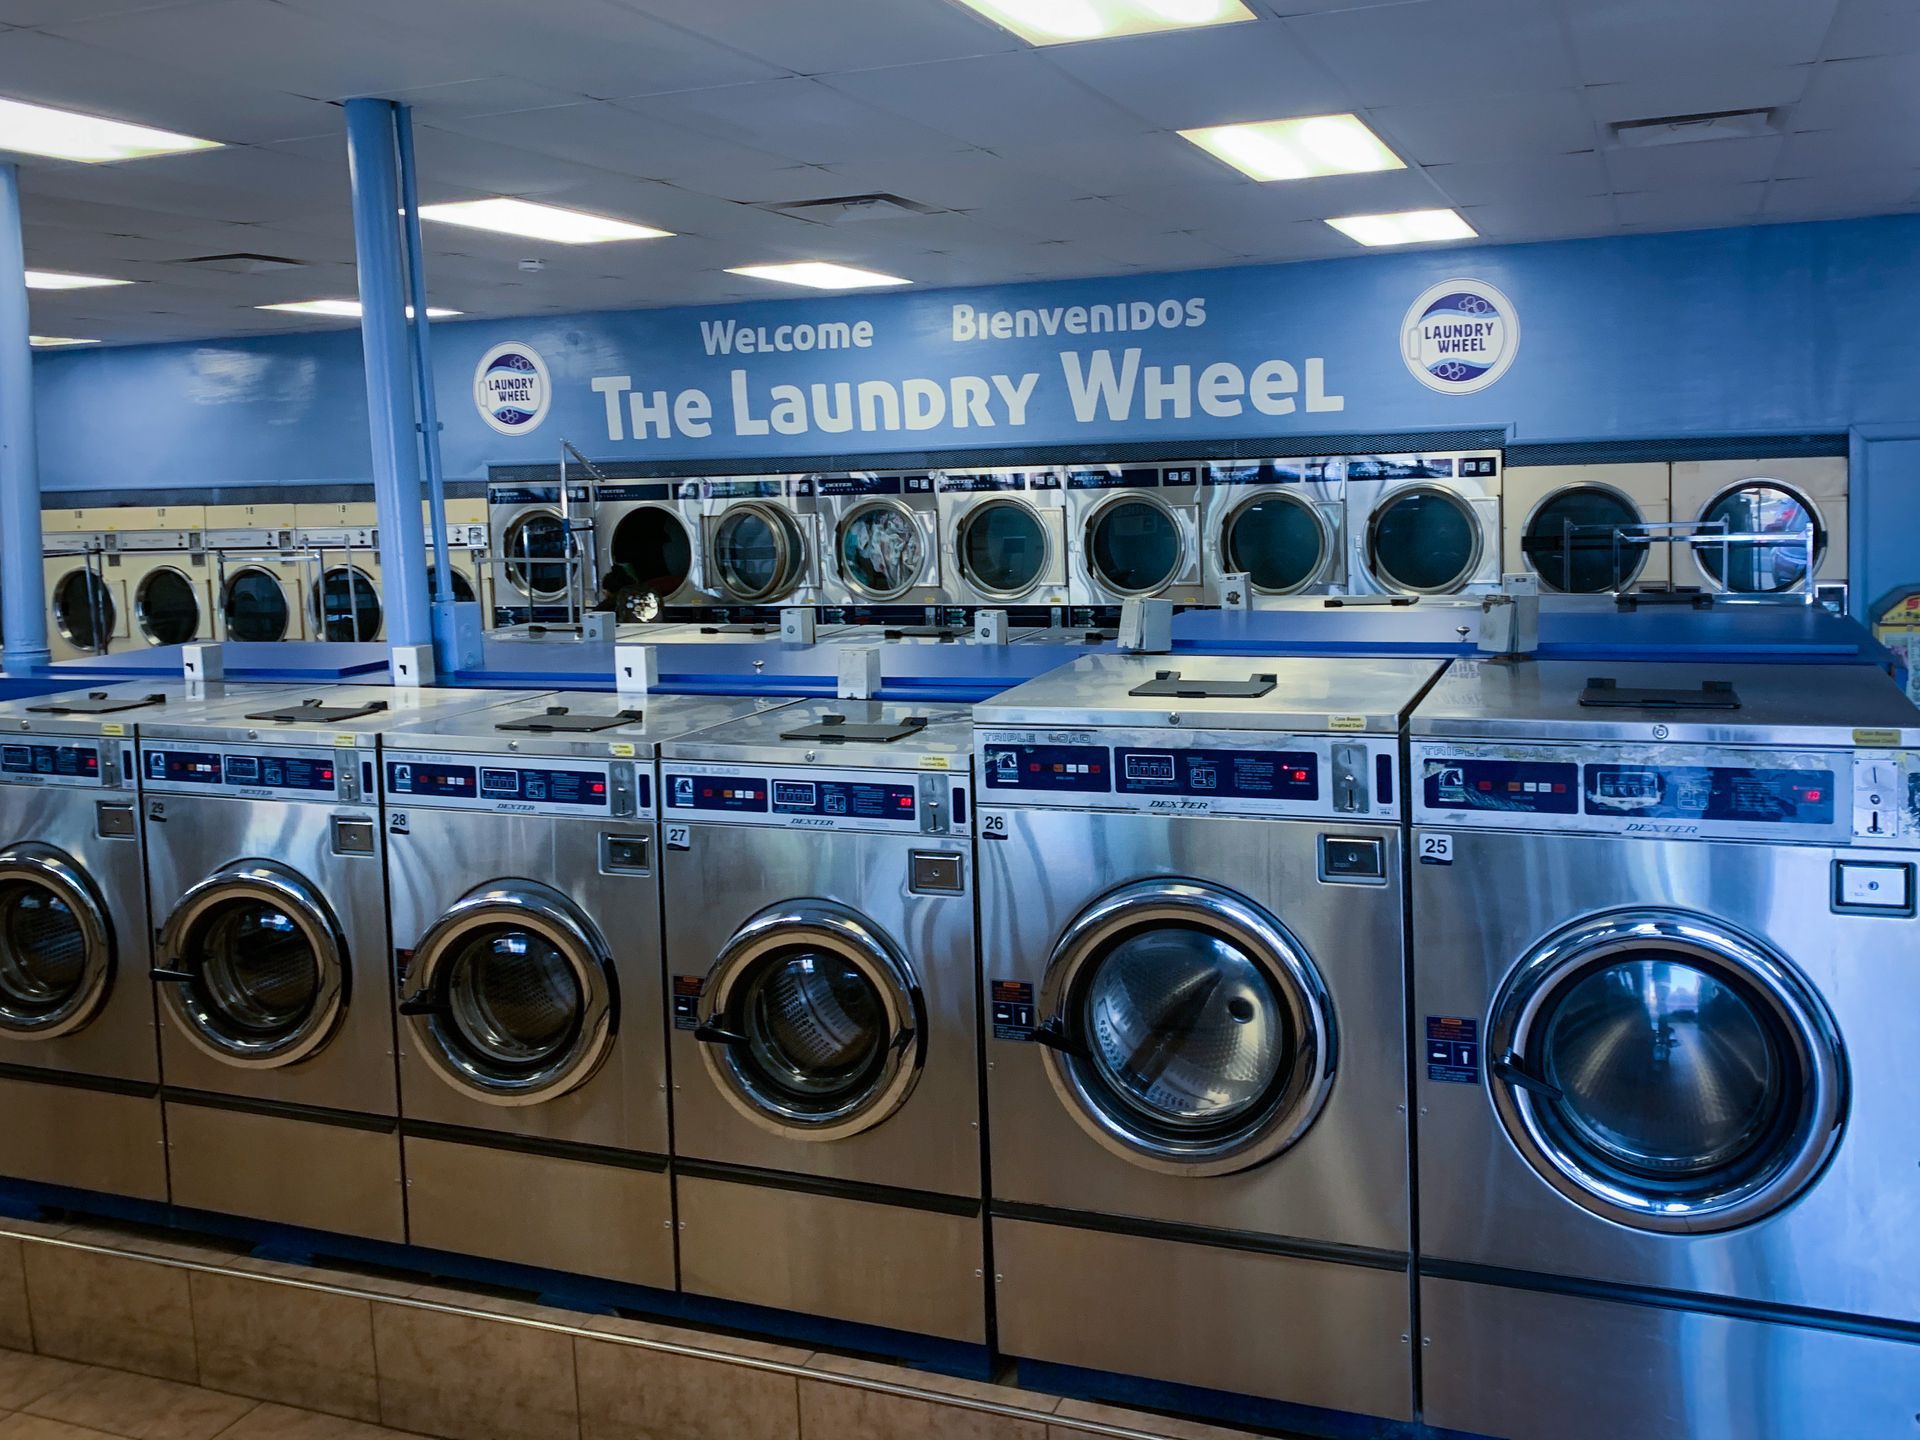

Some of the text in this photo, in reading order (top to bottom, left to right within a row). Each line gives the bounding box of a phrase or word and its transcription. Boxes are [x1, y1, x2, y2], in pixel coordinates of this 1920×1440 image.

[1424, 322, 1494, 340] LAUNDRY
[1437, 338, 1487, 353] WHEEL
[488, 378, 534, 391] LAUNDRY
[498, 390, 531, 402] WHEEL
[983, 732, 1093, 744] TRIPLE LOAD
[496, 803, 536, 811] DEXTER
[1149, 800, 1209, 810] DEXTER
[391, 813, 406, 826] 28
[790, 818, 835, 827] DEXTER
[985, 815, 1003, 830] 26
[669, 828, 687, 842] 27
[1624, 823, 1699, 834] DEXTER
[1425, 838, 1448, 855] 25
